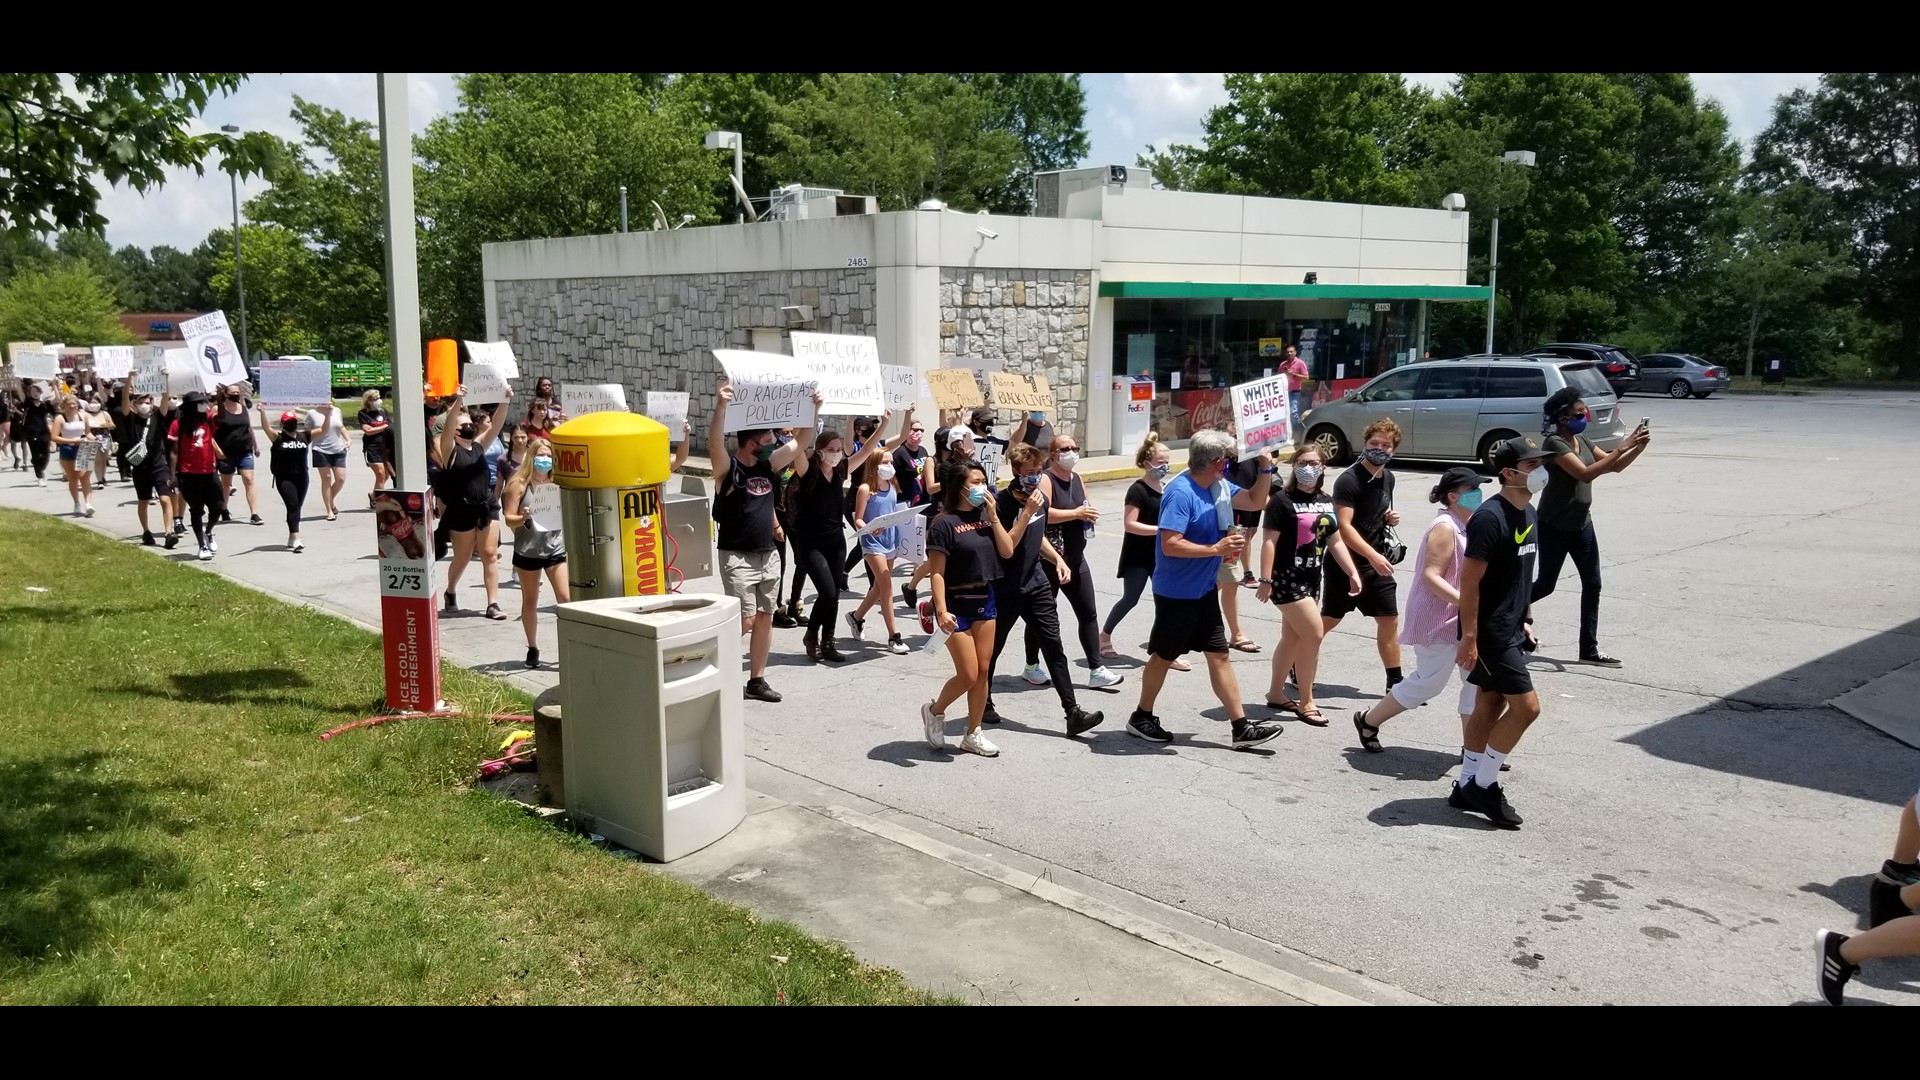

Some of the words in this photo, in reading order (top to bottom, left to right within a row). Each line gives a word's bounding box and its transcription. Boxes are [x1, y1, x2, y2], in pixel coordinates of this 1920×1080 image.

[847, 257, 868, 267] 2483
[1376, 303, 1390, 311] 2483
[566, 391, 595, 401] BLACK
[599, 390, 616, 399] LIVE
[732, 388, 749, 402] NO
[883, 388, 905, 404] tter
[1243, 381, 1280, 403] WHITE
[745, 400, 801, 423] POLICE!
[1127, 404, 1145, 413] FedEx
[1243, 395, 1285, 417] SILENCE
[1246, 422, 1287, 446] CONSENT
[623, 489, 659, 519] AIR
[1293, 502, 1335, 513] IMAGIN
[402, 566, 425, 574] Bottles
[388, 574, 421, 590] 2/$3
[398, 642, 409, 678] COLD
[406, 608, 420, 703] REFRESHMENT
[400, 681, 410, 703] ICE
